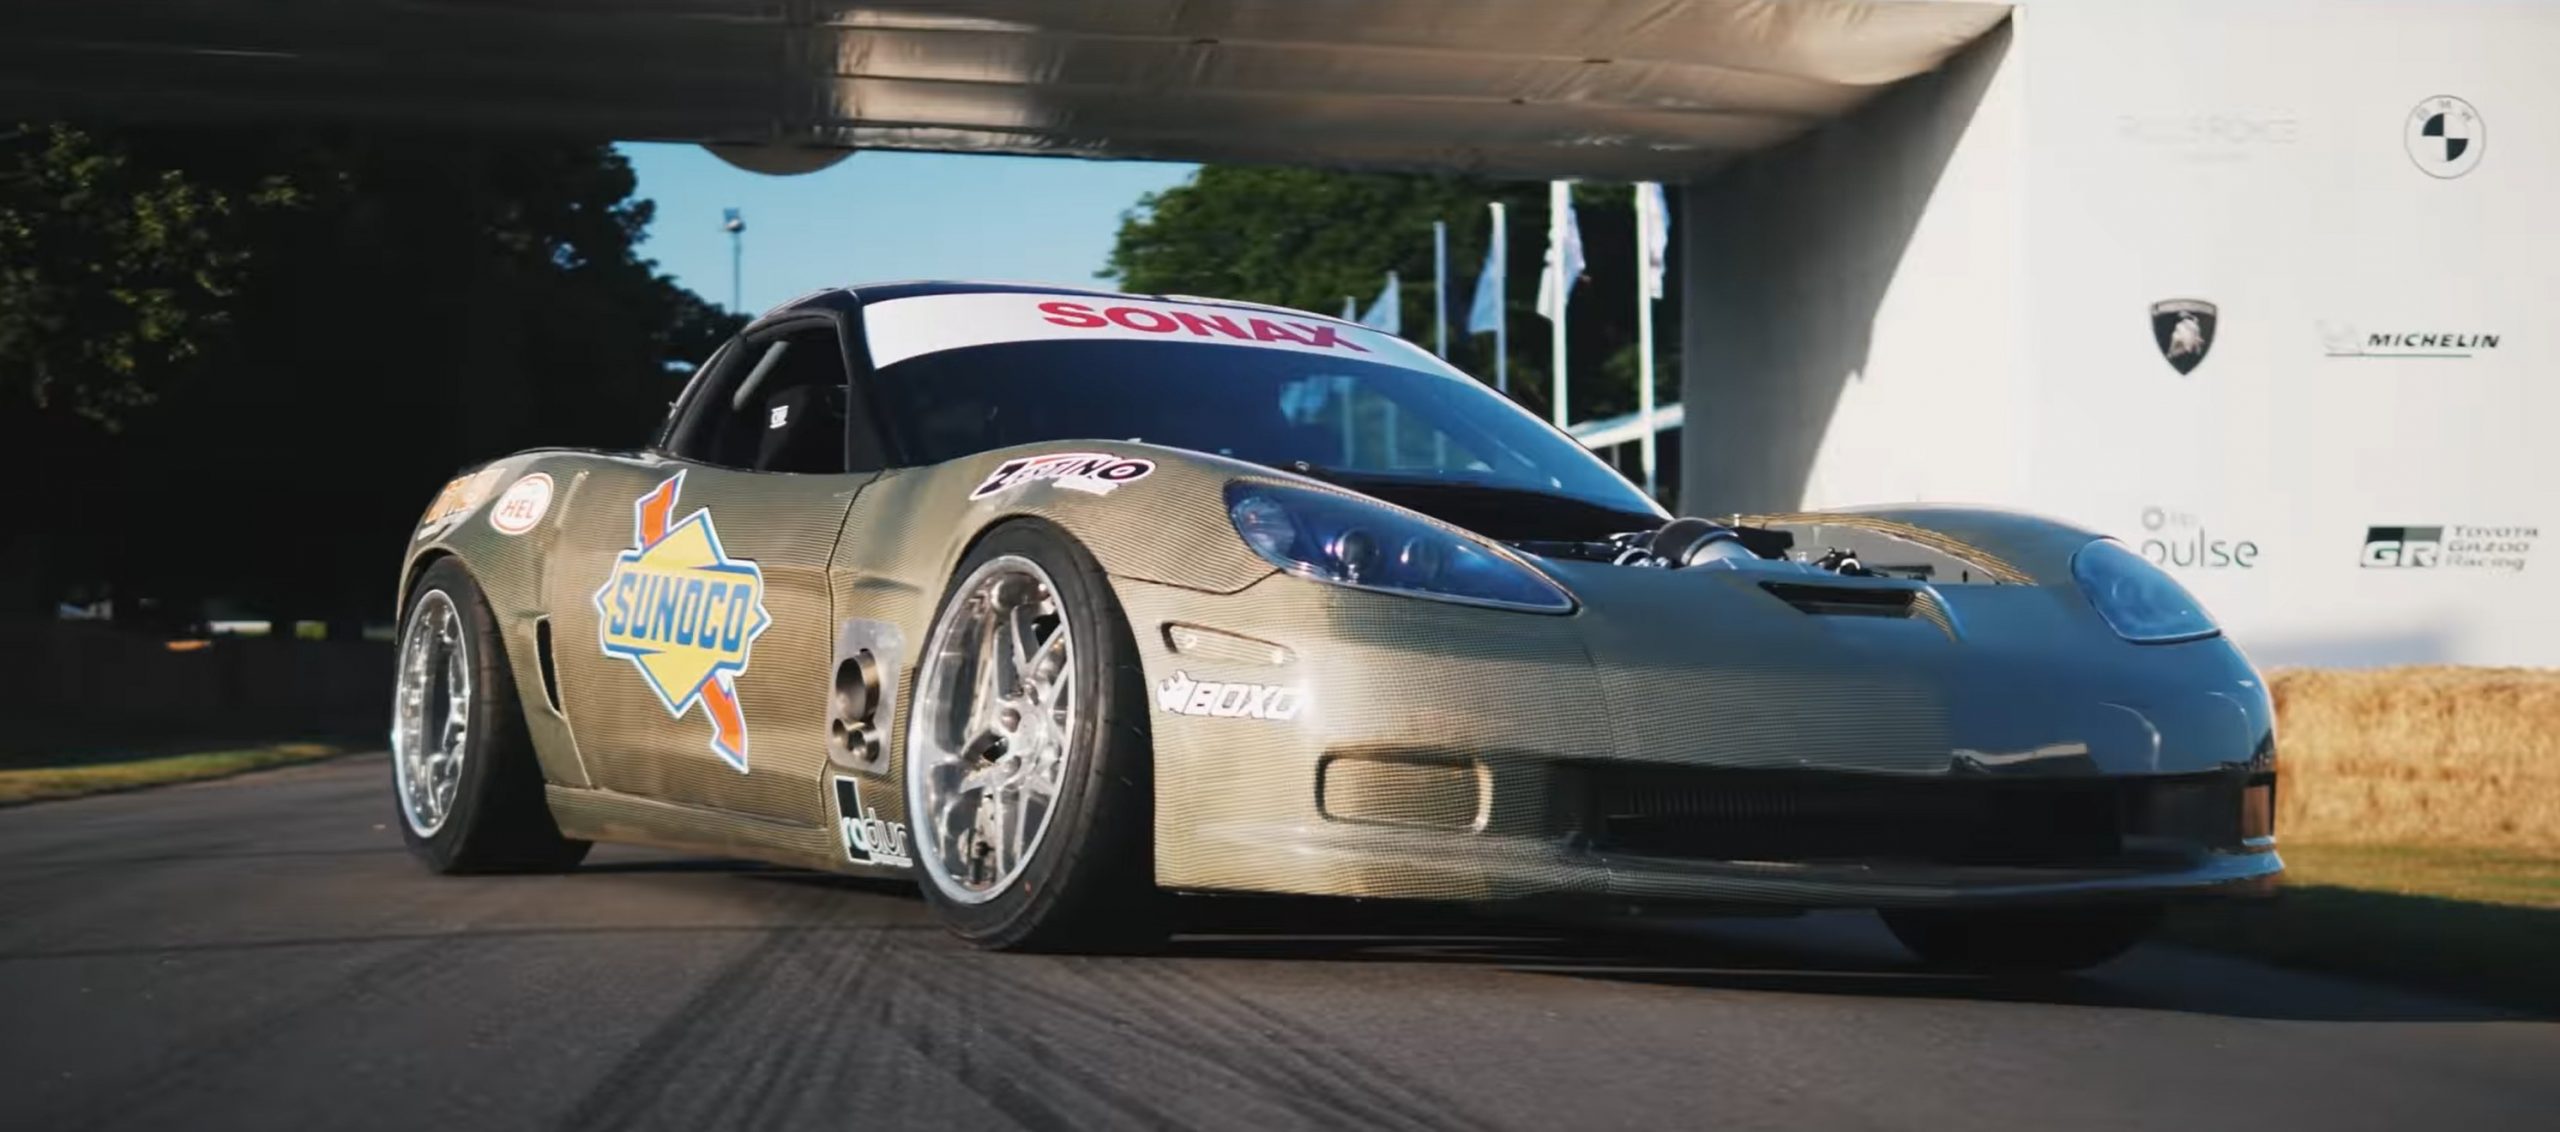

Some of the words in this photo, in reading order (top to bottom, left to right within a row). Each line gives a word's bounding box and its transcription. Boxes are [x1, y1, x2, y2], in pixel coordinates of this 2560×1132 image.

[1038, 301, 1372, 353] SONAX
[2367, 332, 2500, 349] MICHELIN
[501, 499, 535, 519] HEL
[2361, 540, 2440, 568] GR
[609, 571, 752, 653] SUNOCO
[1184, 680, 1306, 719] BOXO
